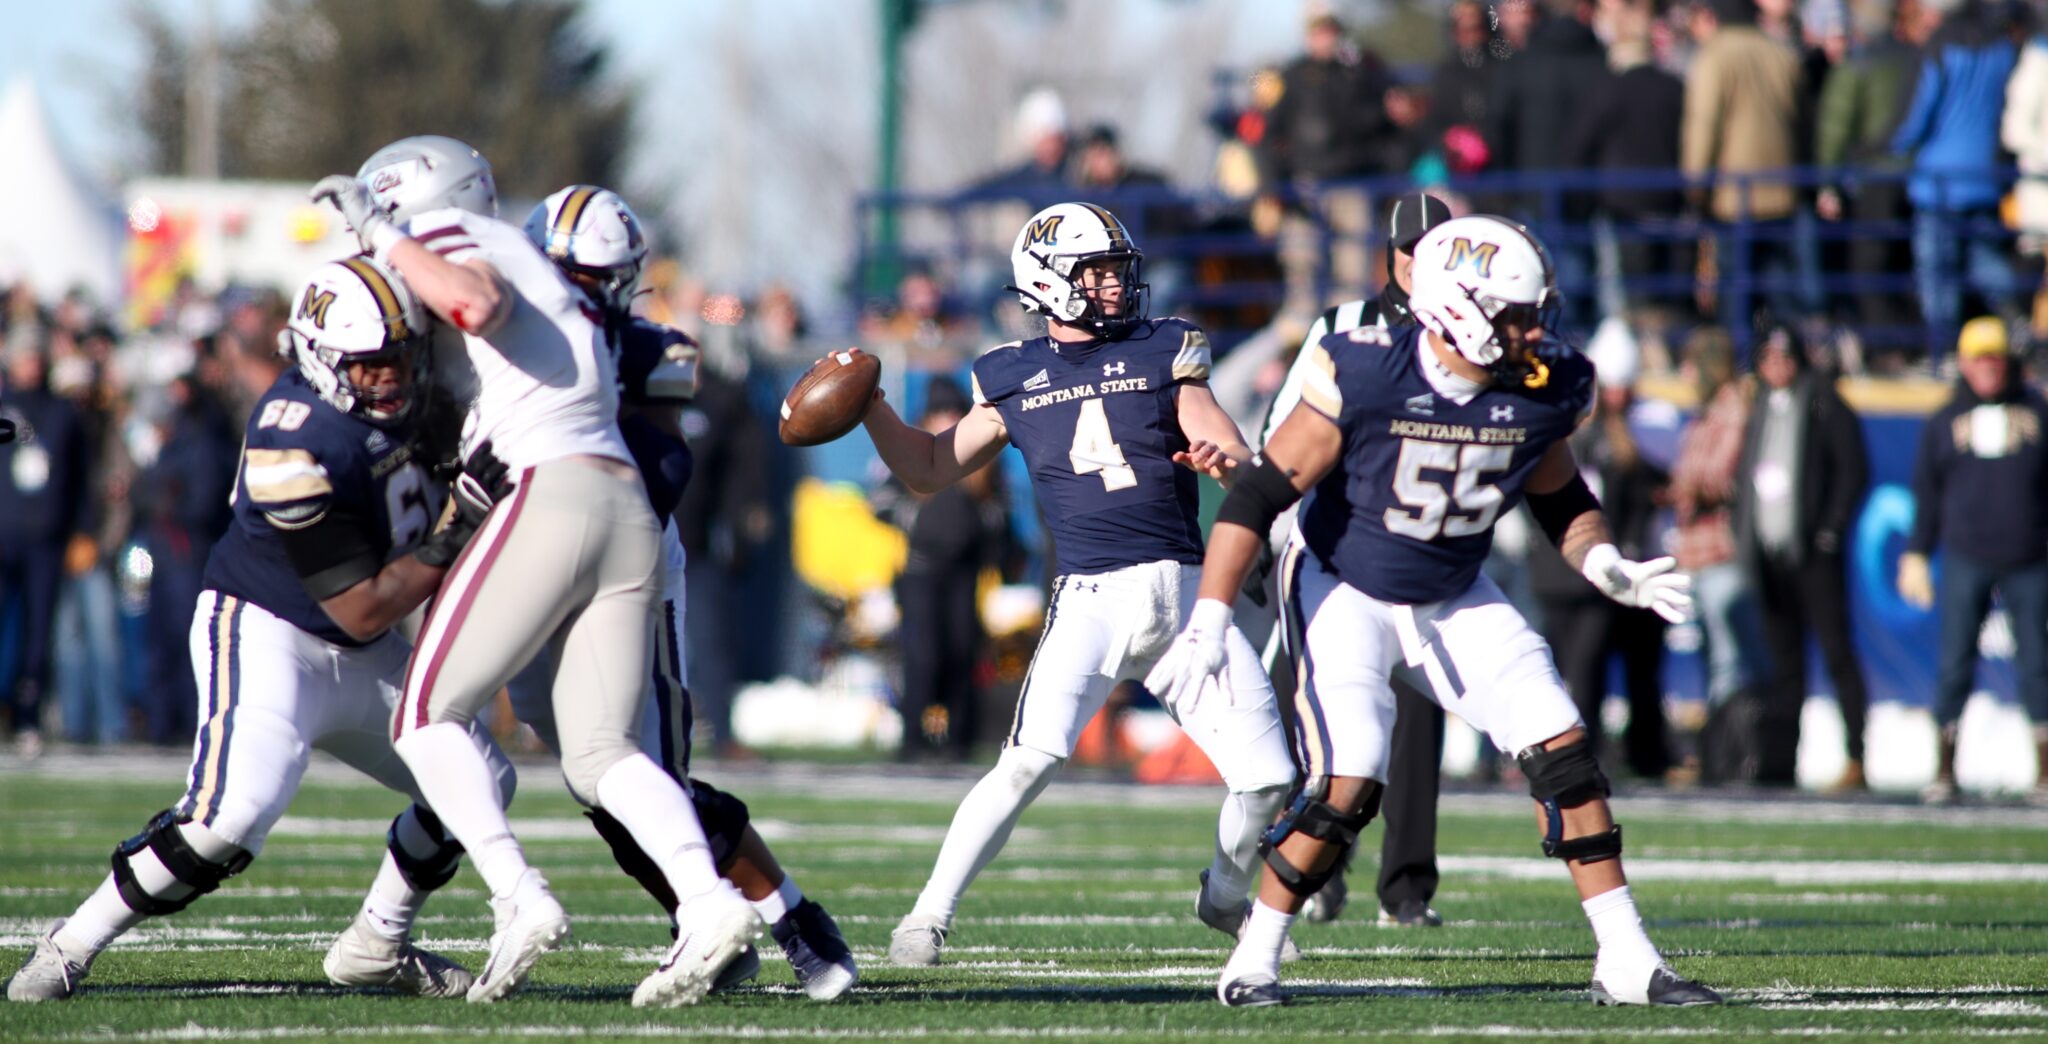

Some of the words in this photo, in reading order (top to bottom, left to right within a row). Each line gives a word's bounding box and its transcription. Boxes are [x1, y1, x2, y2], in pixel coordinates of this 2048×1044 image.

[1022, 215, 1065, 252] M
[1444, 237, 1500, 279] M
[297, 283, 338, 330] M
[1021, 384, 1096, 412] MONTANA
[1100, 377, 1148, 394] STATE
[257, 399, 312, 431] 68
[1389, 419, 1475, 441] MONTANA
[1478, 427, 1527, 443] STATE
[1069, 397, 1138, 493] 4
[1382, 437, 1516, 541] 55
